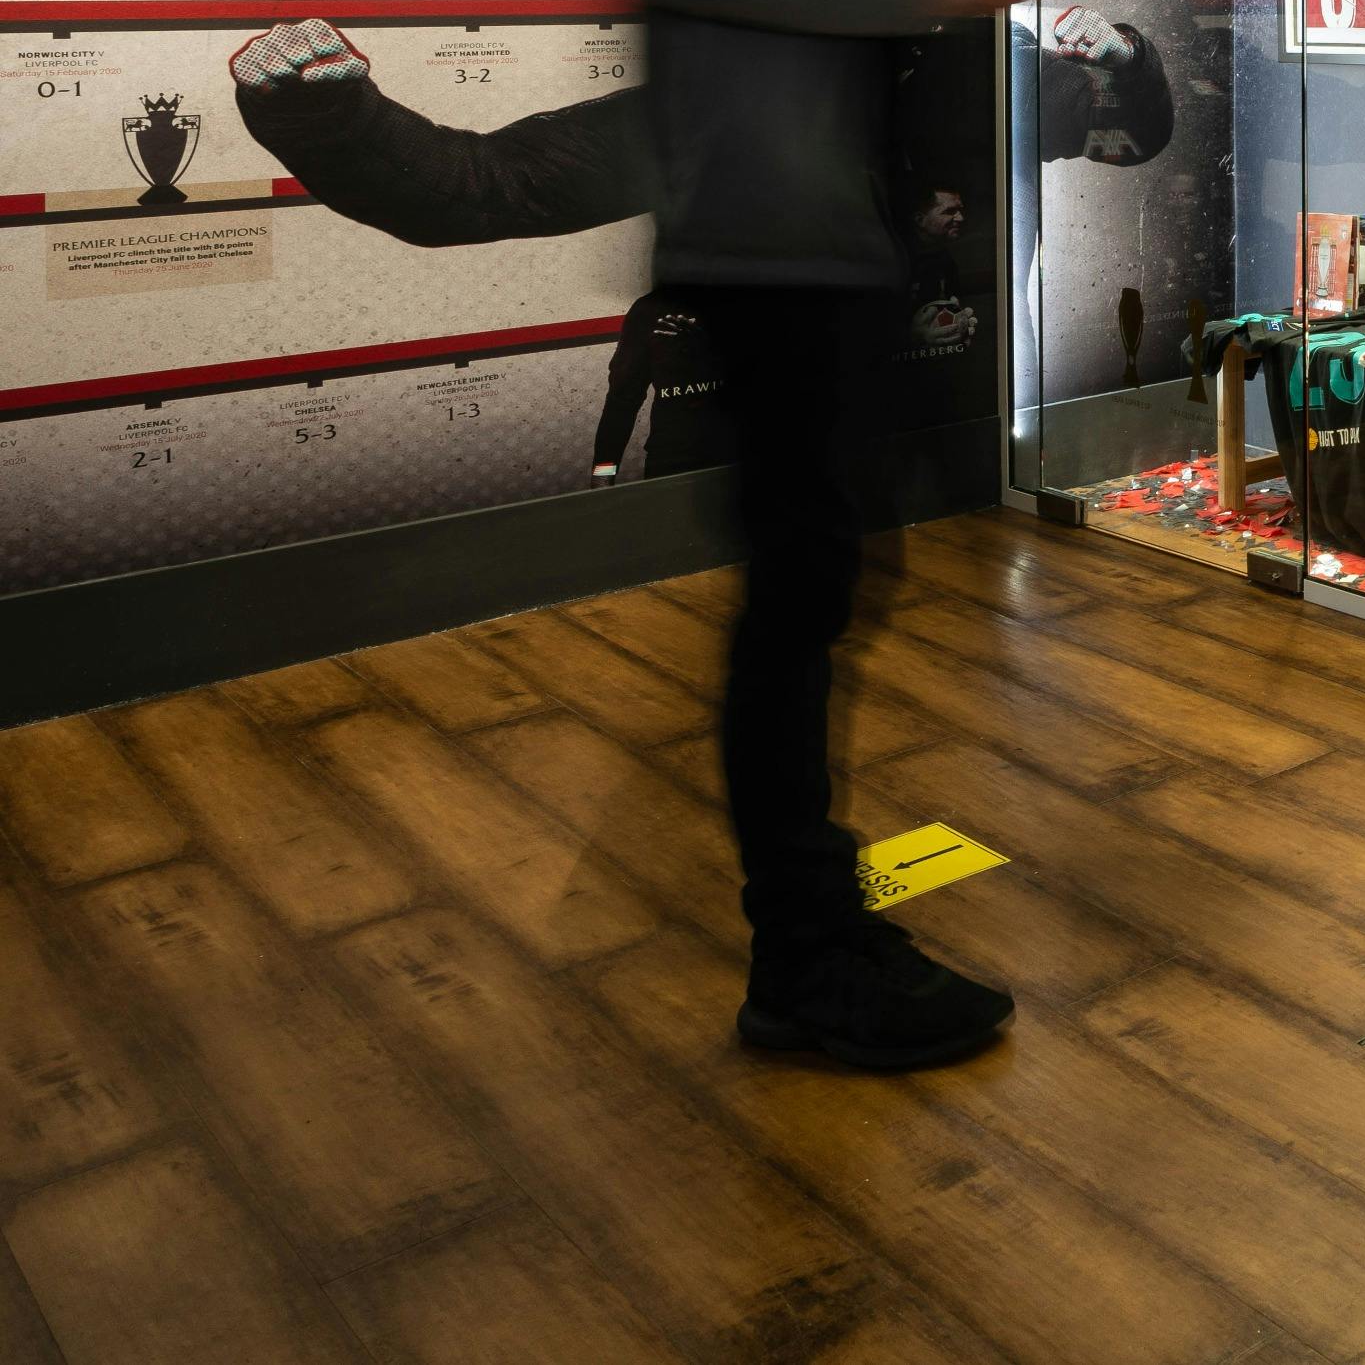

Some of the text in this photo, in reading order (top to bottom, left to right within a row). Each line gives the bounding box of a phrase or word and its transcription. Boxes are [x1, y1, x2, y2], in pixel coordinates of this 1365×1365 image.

[0, 67, 121, 78] Saturday February 2020
[25, 60, 83, 68] LIVERPOOL
[588, 64, 625, 79] 3-0
[454, 68, 492, 83] 3-2
[38, 80, 81, 98] 0-1
[53, 226, 267, 252] PREMIER LEAGUE CHAMPIONS
[68, 252, 111, 263] Liverpool
[113, 250, 126, 258] FC
[128, 248, 155, 258] clinch
[157, 247, 172, 255] the
[173, 245, 191, 253] title
[193, 243, 212, 251] with
[227, 241, 253, 250] points
[69, 262, 92, 271] after
[94, 258, 148, 270] Manchester
[150, 256, 168, 265] City
[197, 252, 217, 260] beat
[219, 249, 253, 258] Chelsea
[113, 261, 213, 276] Thursday June 2020
[417, 374, 499, 391] NEWCASTLE UNITED
[295, 405, 336, 416] CHELSEA
[448, 403, 481, 422] 1-3
[126, 419, 172, 430] ARSENAL
[295, 424, 337, 444] 5-3
[132, 448, 172, 469] 2-1
